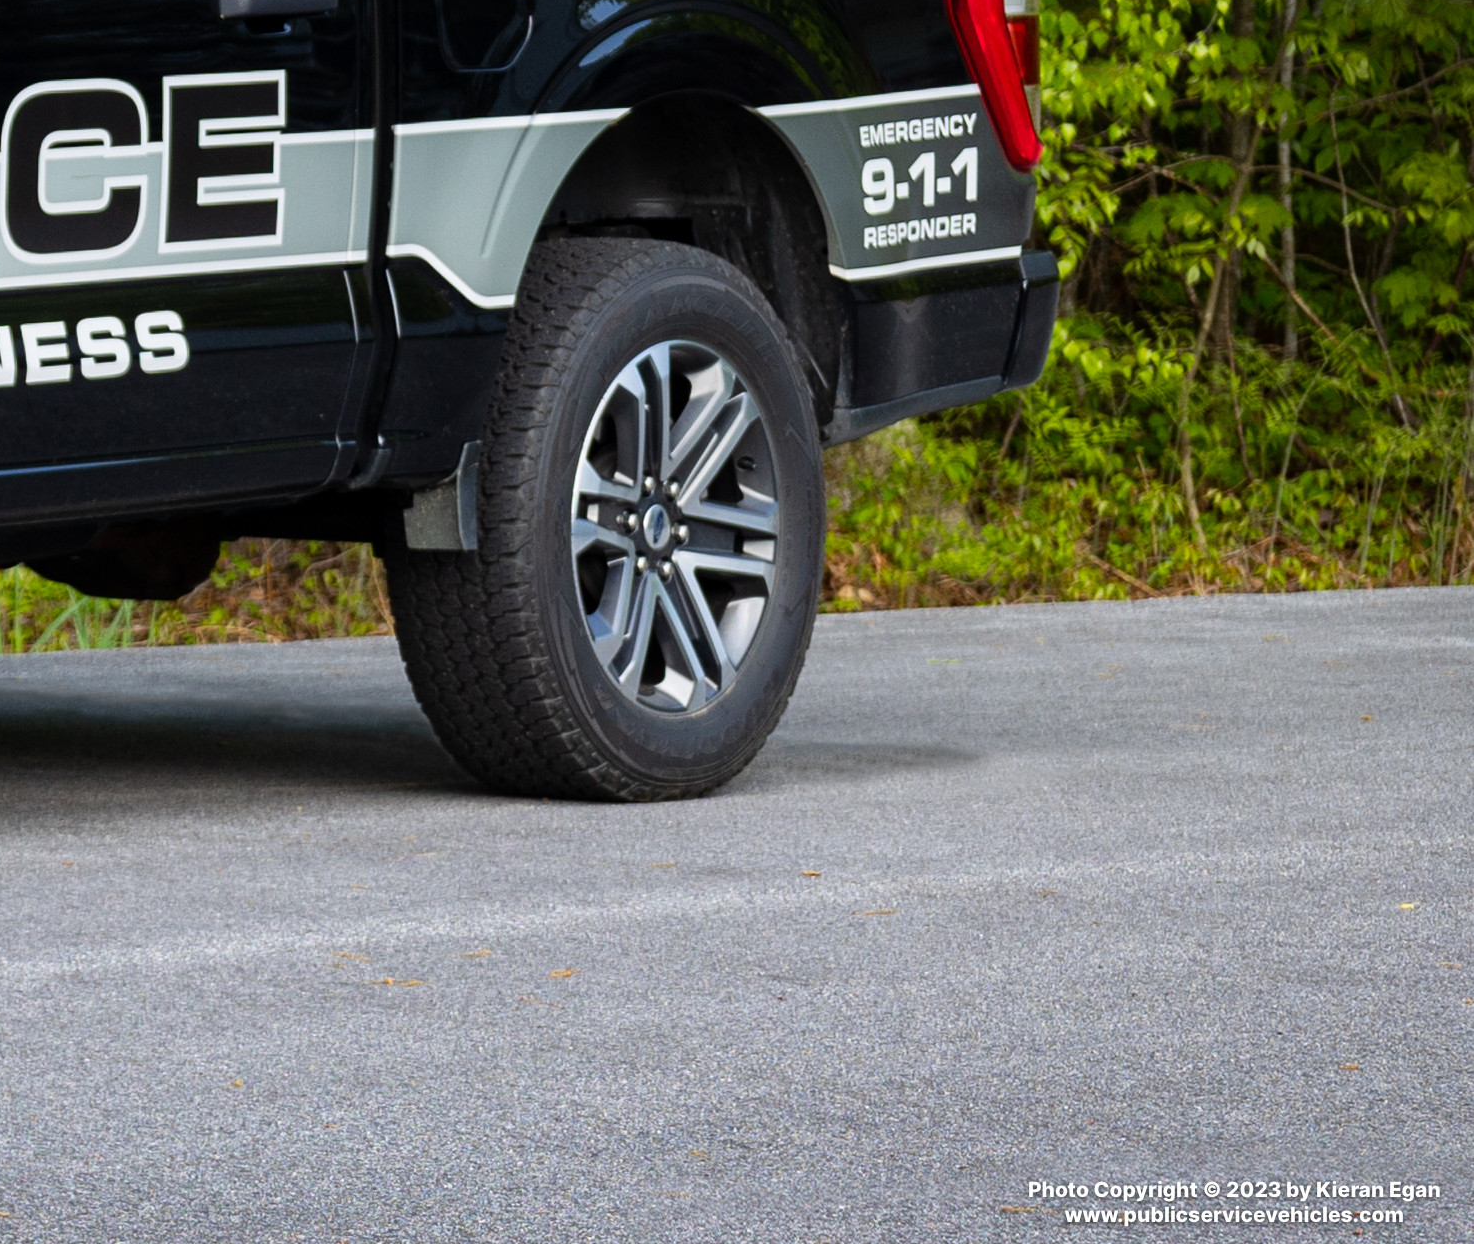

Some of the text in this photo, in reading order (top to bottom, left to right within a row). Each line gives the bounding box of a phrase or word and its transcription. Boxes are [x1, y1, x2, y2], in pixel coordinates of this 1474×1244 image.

[859, 113, 977, 147] EMERGENCY
[861, 146, 978, 216] 9-1-1
[863, 212, 977, 249] RESPONDER
